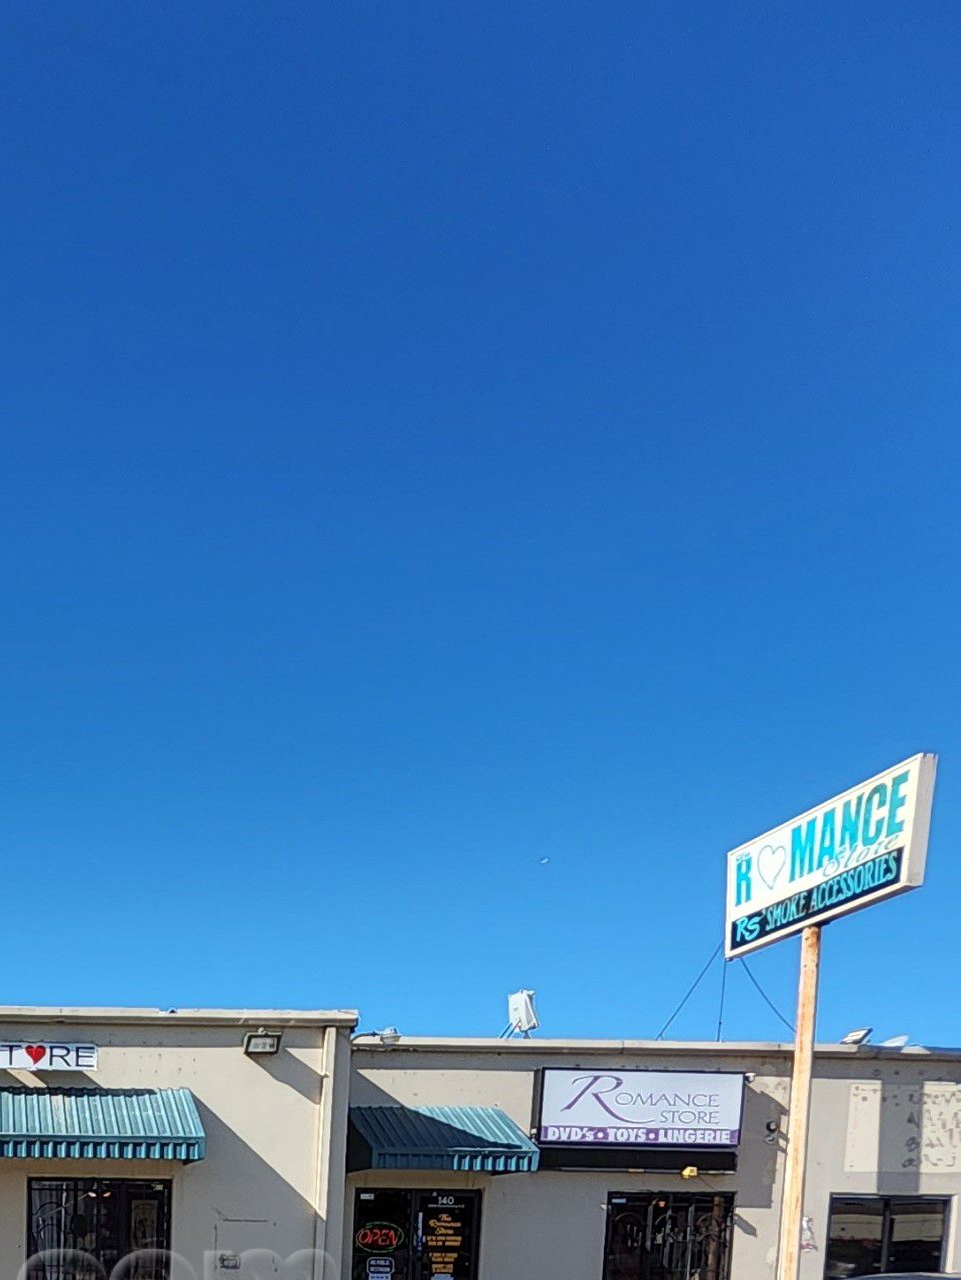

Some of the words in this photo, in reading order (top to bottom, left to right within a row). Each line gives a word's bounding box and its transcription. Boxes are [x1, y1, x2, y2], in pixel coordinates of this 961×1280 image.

[735, 769, 911, 908] RMANCE
[765, 891, 808, 930] SMOKE
[809, 852, 898, 914] ACCESSORIES
[659, 1110, 720, 1125] STORE
[547, 1126, 596, 1141] DVD's
[607, 1128, 648, 1142] TOYS
[658, 1129, 731, 1144] LINGERIE
[438, 1196, 455, 1205] 140
[358, 1229, 399, 1247] OPEN
